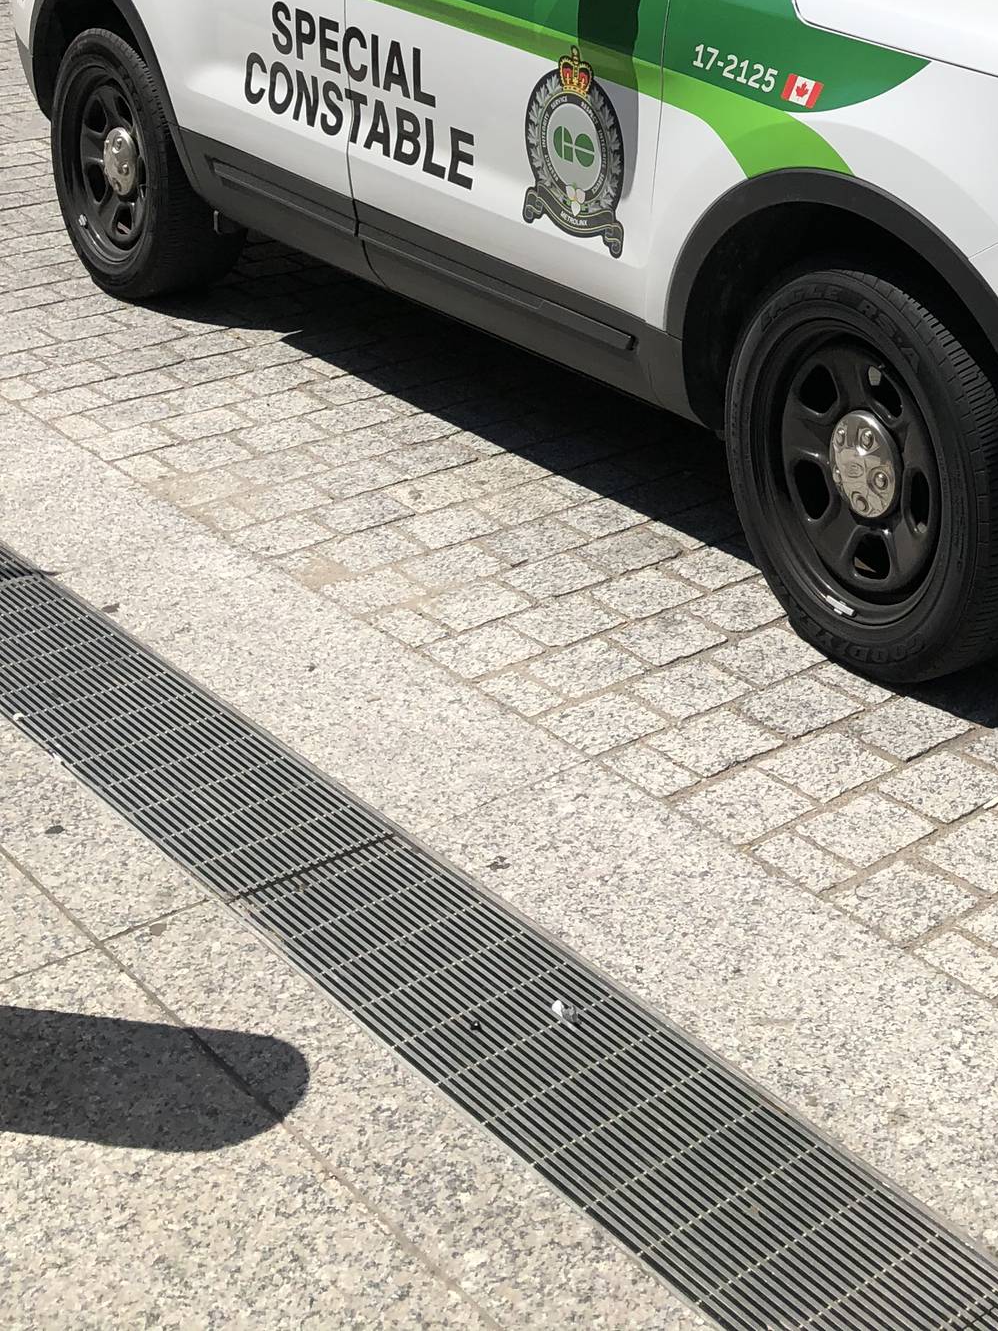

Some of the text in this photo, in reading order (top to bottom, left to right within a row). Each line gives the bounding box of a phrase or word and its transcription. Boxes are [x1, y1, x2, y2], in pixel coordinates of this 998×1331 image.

[272, 1, 436, 108] SPECIAL
[692, 44, 778, 93] 17-2125
[244, 52, 475, 190] CONSTABLE
